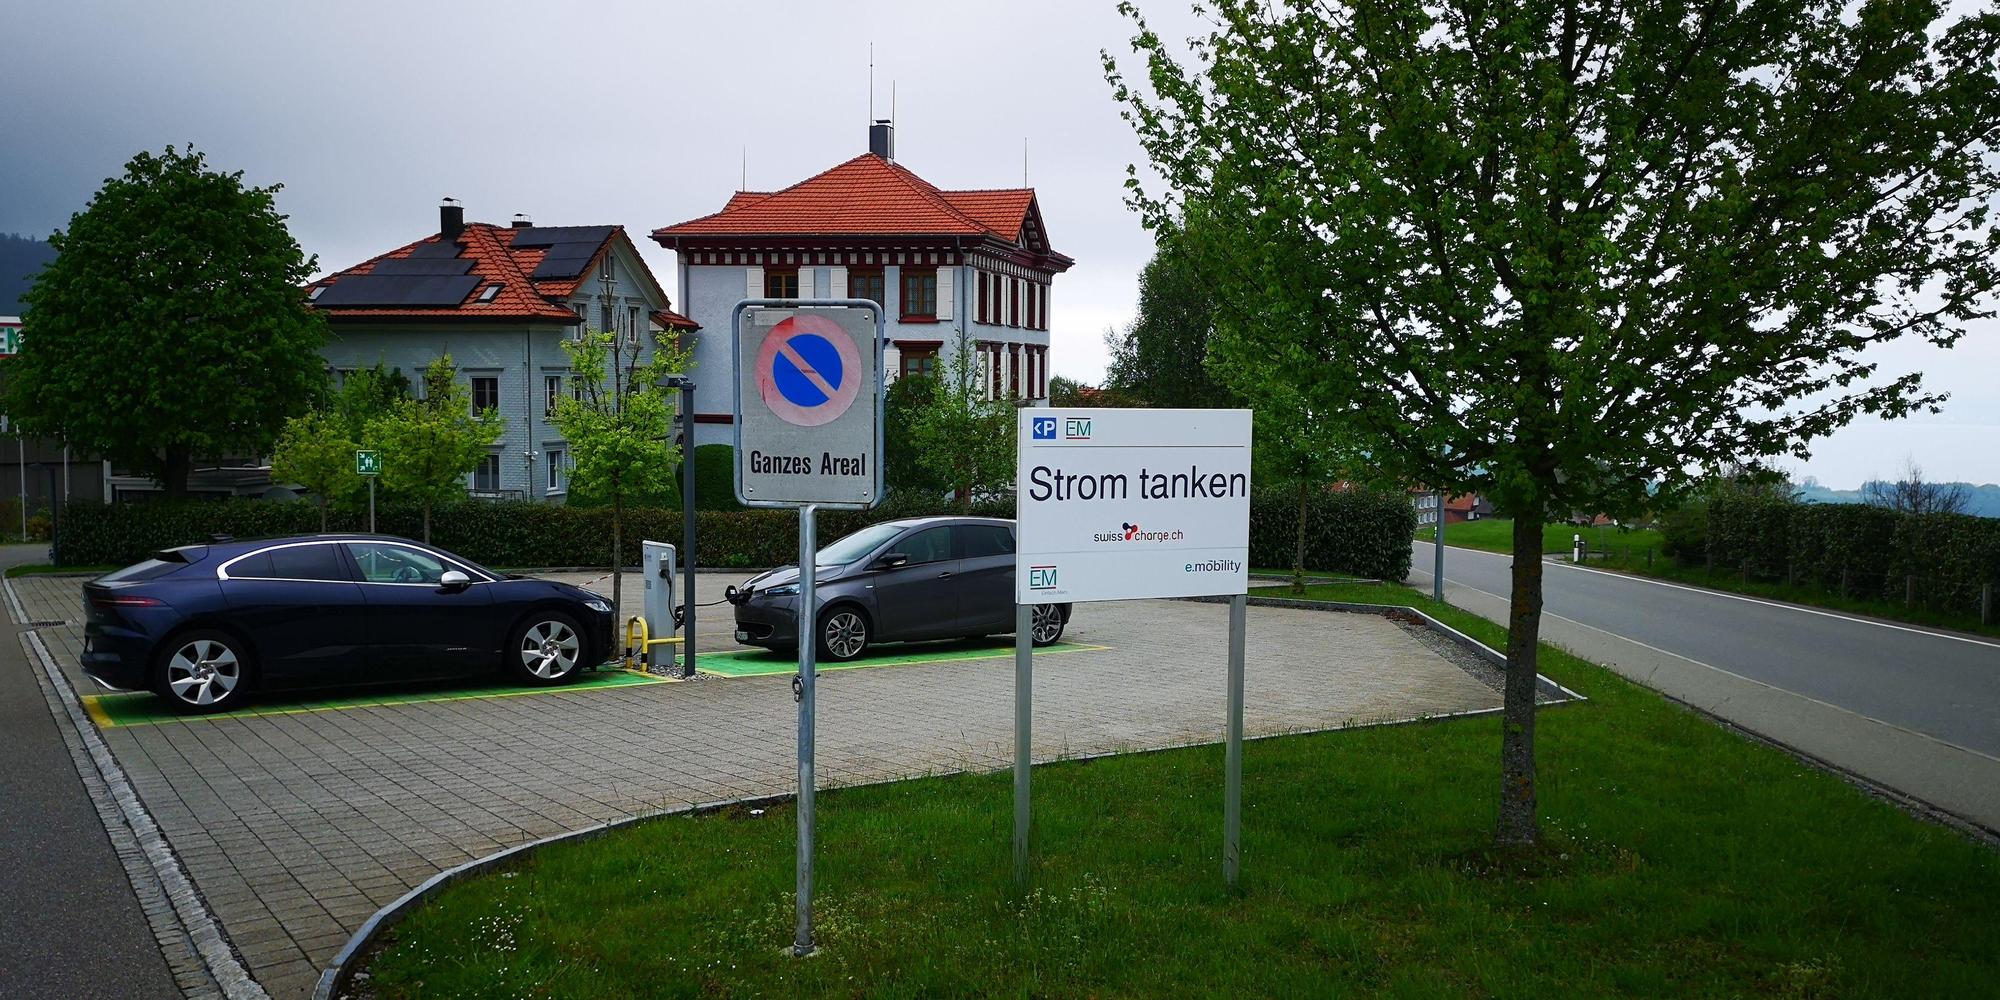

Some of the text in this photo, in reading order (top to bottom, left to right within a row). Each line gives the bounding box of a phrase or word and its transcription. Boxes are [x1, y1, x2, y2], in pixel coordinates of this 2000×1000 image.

[1043, 420, 1055, 437] P
[1065, 420, 1091, 436] EM
[750, 450, 866, 476] Ganzes Areal
[1029, 465, 1246, 502] Strom tanken
[1093, 529, 1184, 543] swiss charge.ch
[1030, 569, 1057, 587] EM
